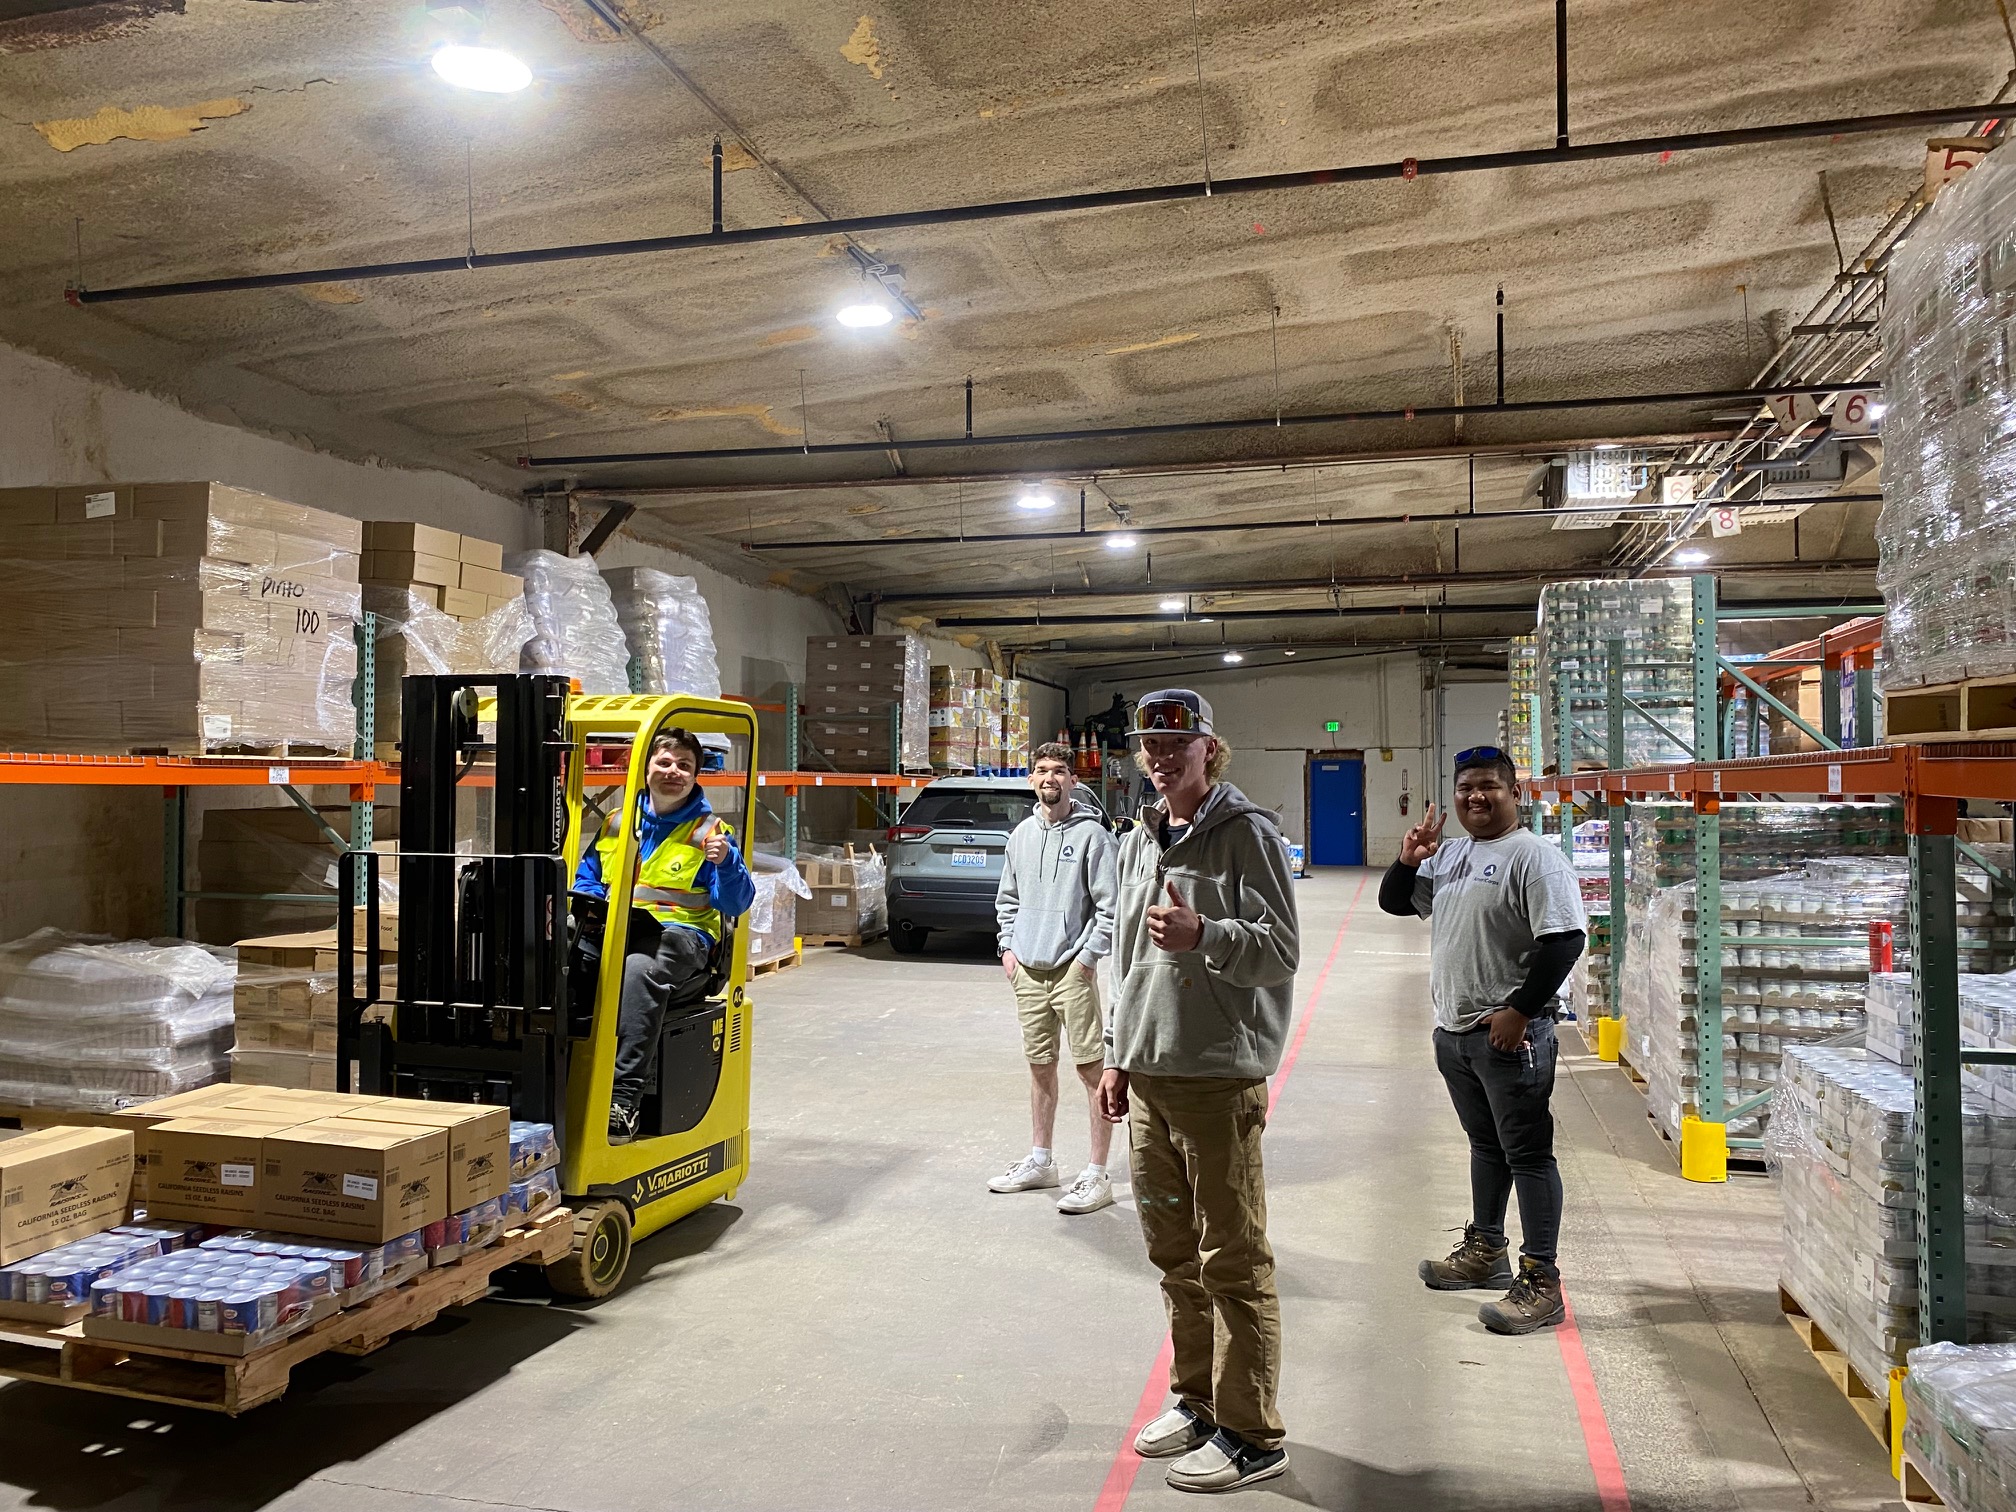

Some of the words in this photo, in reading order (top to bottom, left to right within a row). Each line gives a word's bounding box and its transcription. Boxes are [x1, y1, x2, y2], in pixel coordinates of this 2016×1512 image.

[1845, 394, 1868, 424] 6
[1719, 508, 1735, 530] 8
[296, 608, 320, 635] 100
[157, 1182, 191, 1192] CALIFORNIA
[193, 1185, 220, 1195] SEEDLESS
[221, 1188, 243, 1197] RAISINS
[17, 1209, 59, 1228] CALIFORNIA
[60, 1199, 91, 1215] SEEDLESS
[92, 1191, 117, 1204] RAISINS
[275, 1193, 310, 1204] CALIFORNIA
[311, 1198, 340, 1208] SEEDLESS
[341, 1201, 365, 1211] RAISINS
[51, 1218, 59, 1227] 15
[60, 1215, 72, 1224] OZ.
[73, 1210, 87, 1220] BAG
[323, 1209, 336, 1217] BAG
